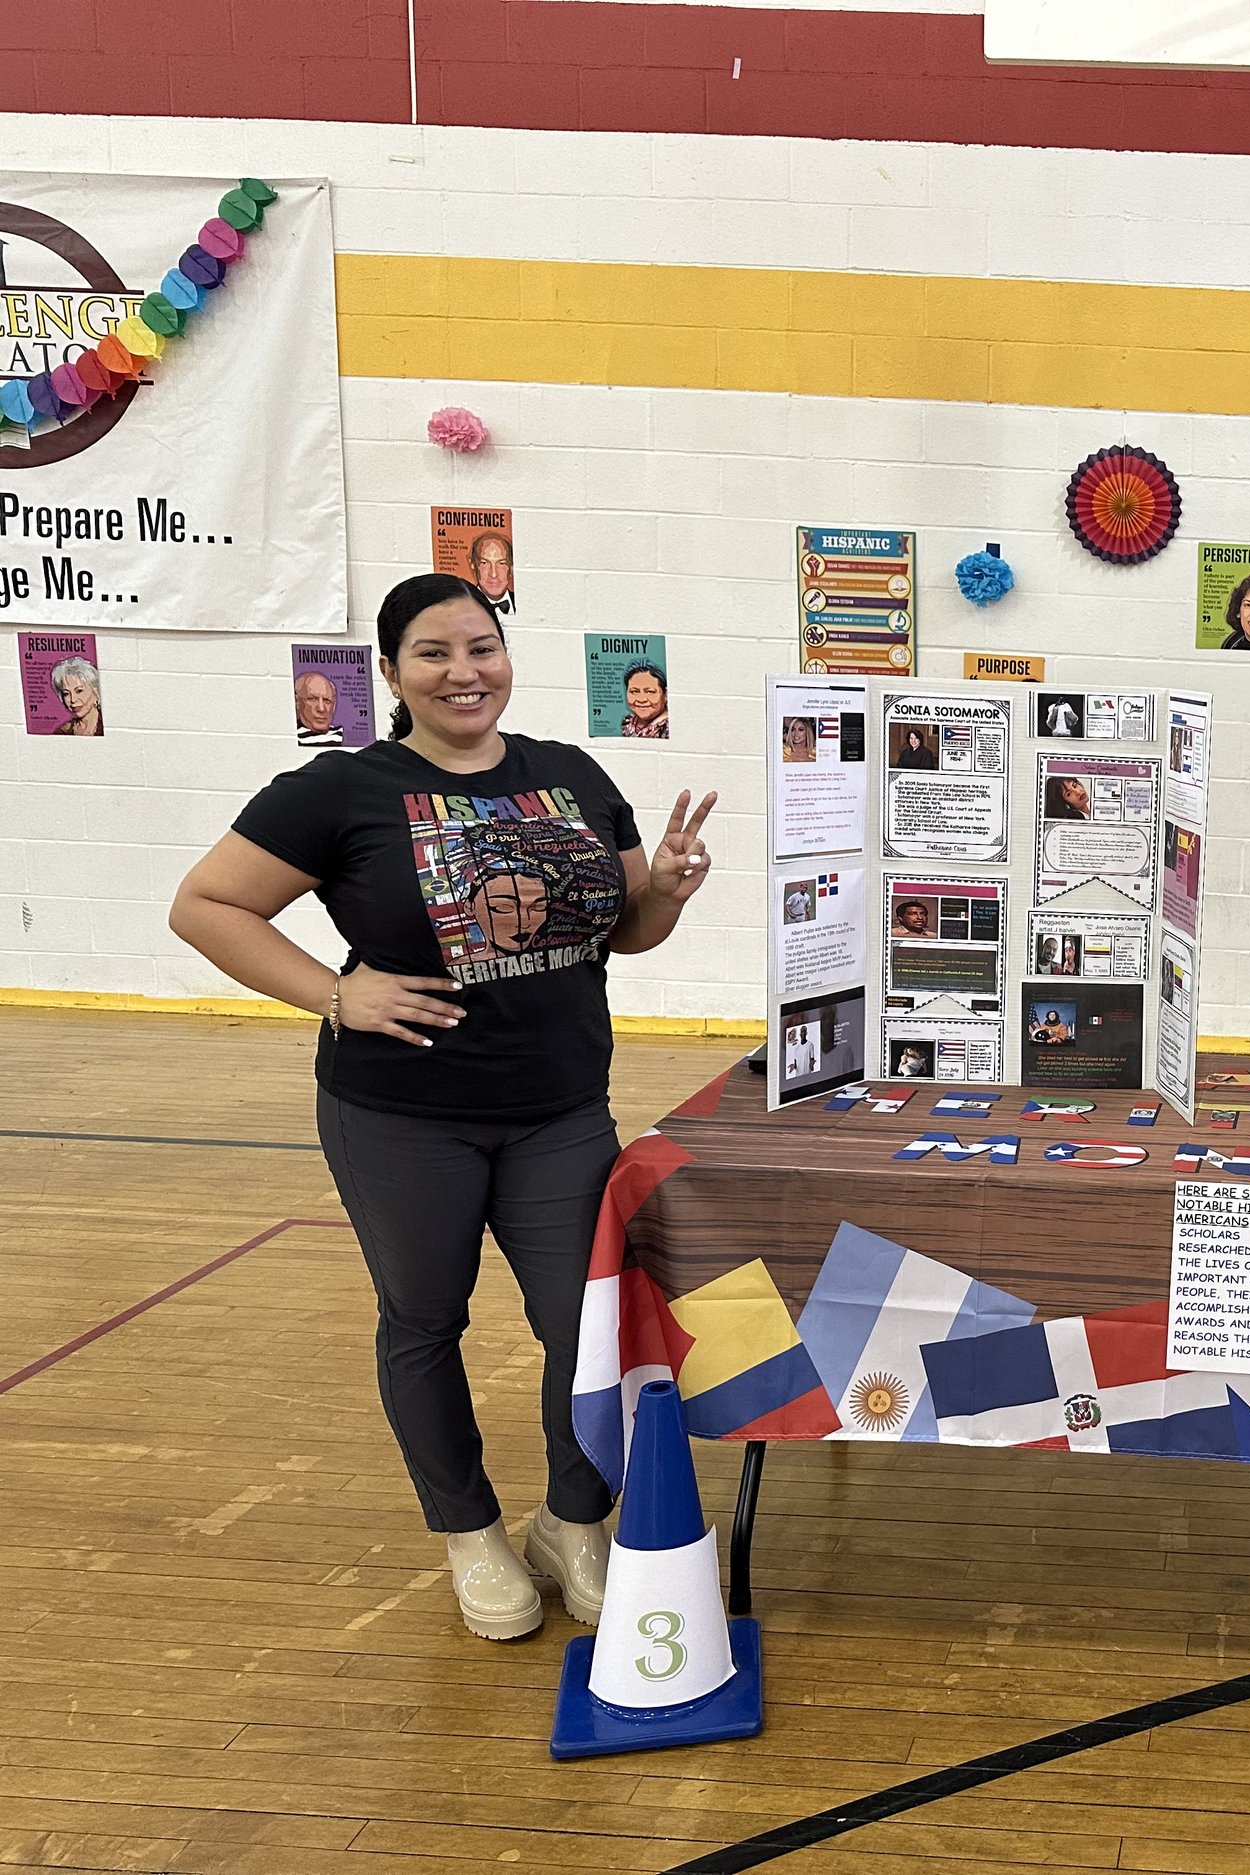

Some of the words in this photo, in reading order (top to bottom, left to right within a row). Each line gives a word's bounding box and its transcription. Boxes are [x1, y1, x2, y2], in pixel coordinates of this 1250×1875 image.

[0, 492, 123, 549] Prepare
[438, 511, 505, 528] CONFIDENCE
[822, 536, 890, 550] HISPANIC
[28, 638, 86, 652] RESILIENCE
[602, 638, 648, 654] DIGNITY
[298, 649, 364, 664] INNOVATION
[978, 658, 1030, 675] PURPOSE
[894, 704, 930, 716] SONIA
[934, 706, 1000, 719] SOTOMAYOR
[403, 788, 581, 820] HISPANIC
[485, 833, 520, 843] Peru
[512, 840, 588, 851] Venezuela
[447, 951, 546, 985] HERITAGE
[1178, 1185, 1208, 1198] HERE
[1214, 1187, 1236, 1199] ARE
[1177, 1199, 1233, 1212] NOTABLE
[1176, 1214, 1249, 1227] AMERICANS
[1179, 1228, 1240, 1240] SCHOLARS
[1178, 1258, 1201, 1267] THE
[1205, 1259, 1240, 1270] LIVES
[1177, 1273, 1247, 1284] IMPORTANT
[1176, 1287, 1220, 1299] PEOPLE,
[1175, 1317, 1225, 1328] AWARDS
[1174, 1331, 1229, 1343] REASONS
[1173, 1345, 1226, 1357] NOTABLE
[634, 1610, 688, 1682] 3
